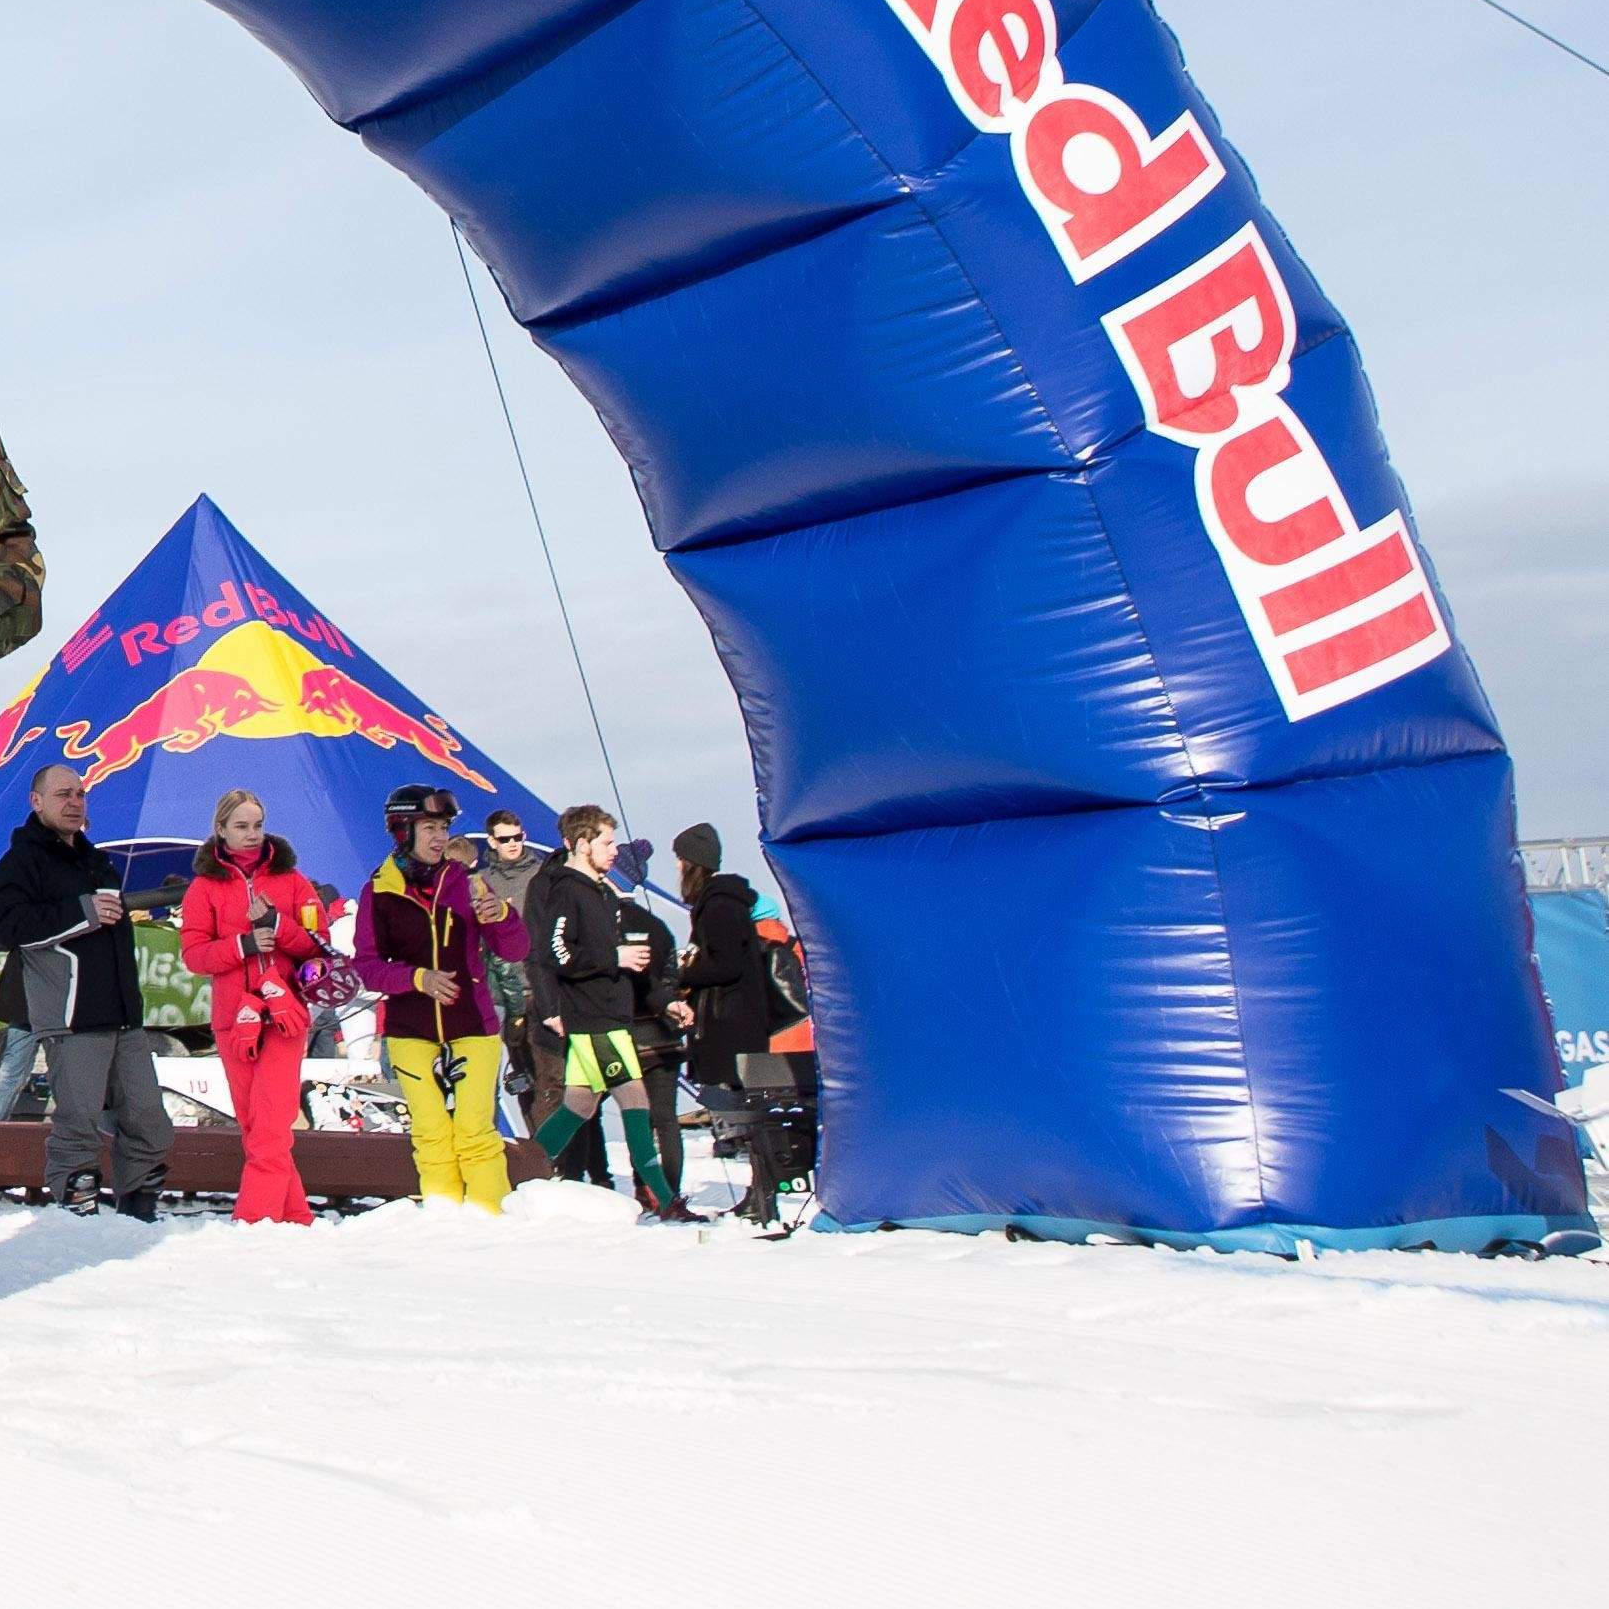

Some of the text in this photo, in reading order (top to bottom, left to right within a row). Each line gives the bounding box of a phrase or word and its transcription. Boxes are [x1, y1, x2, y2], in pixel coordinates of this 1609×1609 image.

[1120, 239, 1439, 697] Bull
[120, 581, 246, 667] Red
[243, 582, 354, 658] Bull
